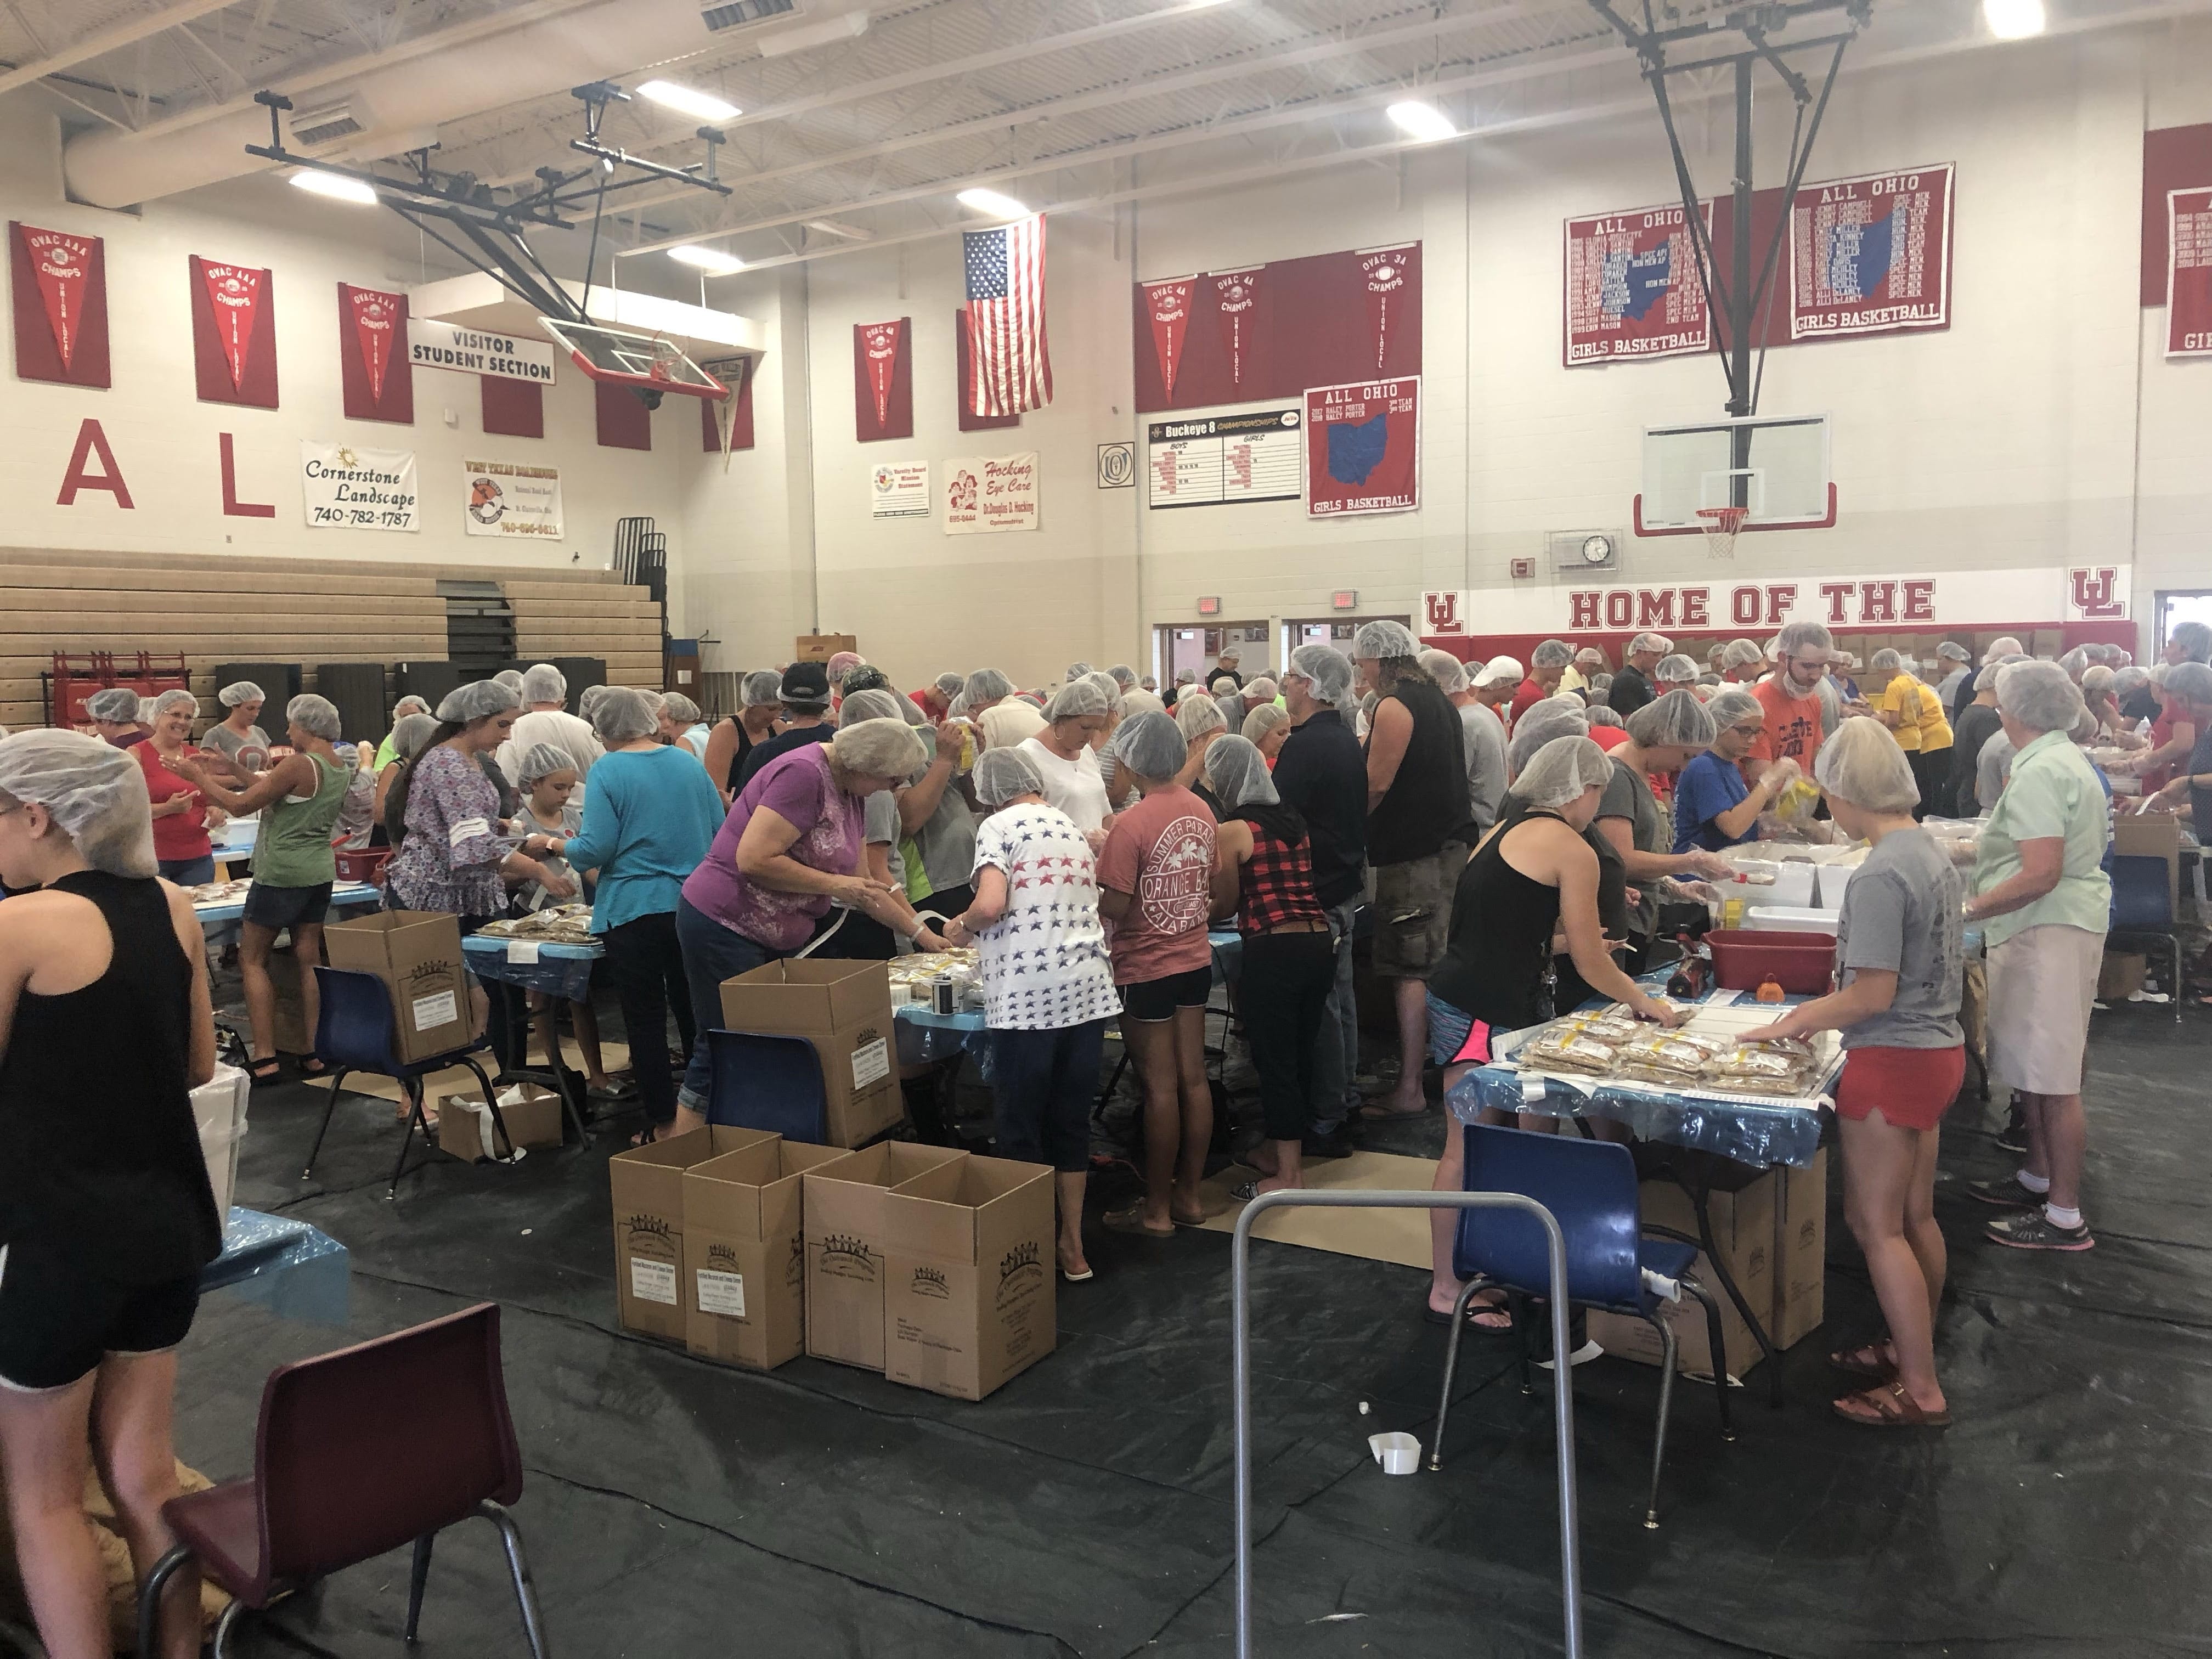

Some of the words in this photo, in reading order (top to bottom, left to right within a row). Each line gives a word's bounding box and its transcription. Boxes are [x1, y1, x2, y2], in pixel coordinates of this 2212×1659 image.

[1821, 185, 1857, 204] ALL
[1872, 175, 1919, 196] OHIO
[1595, 219, 1626, 235] ALL
[1644, 210, 1683, 228] OHIO
[31, 235, 60, 248] OVAC
[64, 239, 87, 256] AAA
[41, 262, 81, 278] CHAMPS
[1363, 253, 1387, 271] OVAC
[1394, 254, 1407, 266] 3A
[208, 267, 232, 280] OVAC
[236, 270, 256, 287] AAA
[1217, 275, 1239, 290] OVAC
[1244, 275, 1254, 286] 4A
[1368, 276, 1403, 292] CHAMPS
[59, 282, 67, 318] UNION
[216, 292, 251, 307] CHAMPS
[354, 292, 375, 304] OVAC
[1152, 285, 1173, 300] OVAC
[1176, 286, 1186, 296] 4A
[1155, 308, 1184, 323] CHAMPS
[1221, 298, 1253, 313] CHAMPS
[360, 315, 390, 330] CHAMPS
[1601, 313, 1621, 322] MASON
[1601, 321, 1621, 330] MASON
[1796, 313, 1838, 331] GIRLS
[1840, 303, 1939, 327] BASKETBALL
[453, 330, 514, 355] VISITOR
[1572, 340, 1609, 358] GIRLS
[1613, 330, 1706, 354] BASKETBALL
[413, 343, 484, 369] STUDENT
[489, 357, 551, 380] SECTION
[1325, 390, 1352, 404] ALL
[1363, 384, 1398, 400] OHIO
[1325, 413, 1343, 421] HALEY
[1345, 410, 1365, 419] PORTER
[1399, 404, 1413, 413] TEAM
[1345, 403, 1365, 412] PORTER
[1399, 397, 1413, 405] TEAM
[1165, 425, 1207, 438] Buckeye
[1209, 421, 1216, 433] 8
[1217, 417, 1279, 431] CHAMPIONSHIPS
[1243, 434, 1265, 442] GIRLS
[56, 418, 136, 509] A
[219, 432, 275, 518] L
[306, 460, 400, 484] Cornerstone
[984, 460, 1032, 480] Hocking
[334, 483, 415, 510] Landscape
[986, 480, 1005, 496] Eye
[1007, 478, 1032, 493] Care
[1314, 499, 1342, 513] GIRLS
[1346, 495, 1412, 510] BASKETBALL
[313, 506, 411, 528] 740-782-1787
[1569, 587, 1710, 630] HOME
[1731, 583, 1798, 627] OF
[1819, 578, 1936, 624] THE
[1146, 822, 1184, 873] SUMMER
[1144, 872, 1190, 899] ORANGE
[1195, 869, 1209, 892] BA
